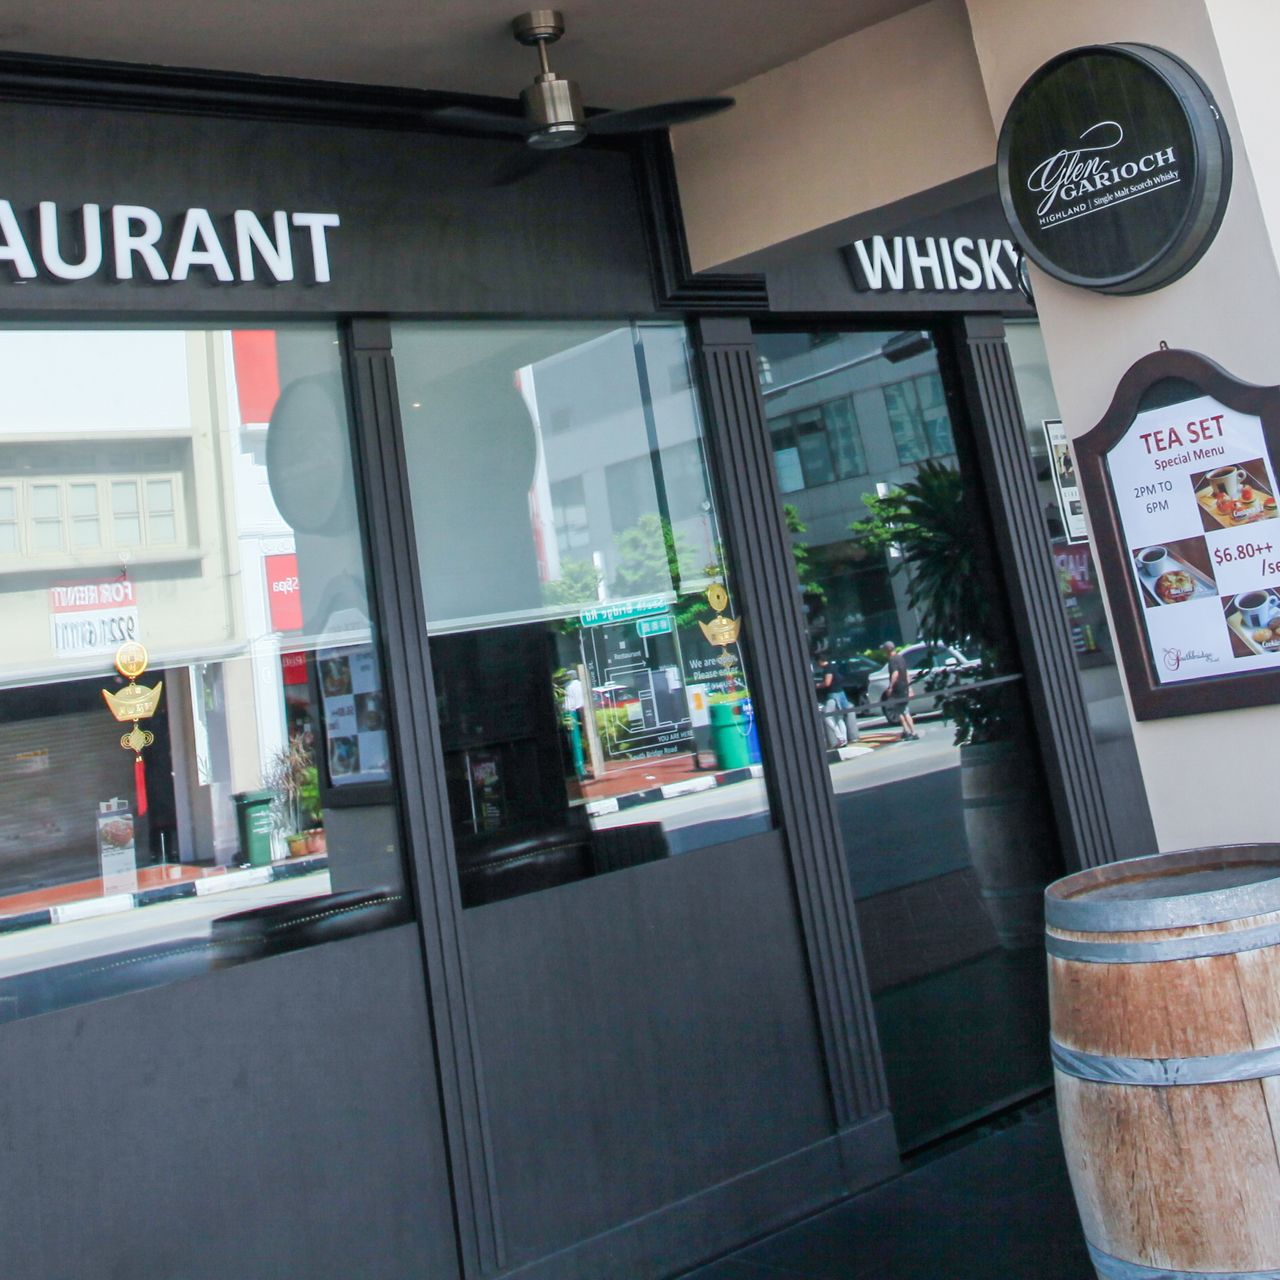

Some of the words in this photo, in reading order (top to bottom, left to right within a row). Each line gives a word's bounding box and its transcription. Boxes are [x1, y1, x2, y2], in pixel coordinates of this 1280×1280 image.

[1028, 121, 1124, 216] Glen
[1060, 147, 1177, 201] GARIOCH
[1039, 203, 1087, 225] HIGHLAND
[1093, 193, 1114, 206] Single
[1114, 187, 1130, 200] Malt
[1130, 178, 1153, 194] Scotch
[1153, 170, 1180, 185] Whisky
[1139, 427, 1183, 455] TEA
[1186, 415, 1225, 444] SET
[1154, 452, 1192, 471] Special
[1193, 446, 1225, 462] Menu
[1134, 483, 1157, 499] 2PM
[1158, 480, 1173, 493] TO
[1146, 499, 1169, 514] 6PM
[1213, 541, 1273, 567] $6.80++
